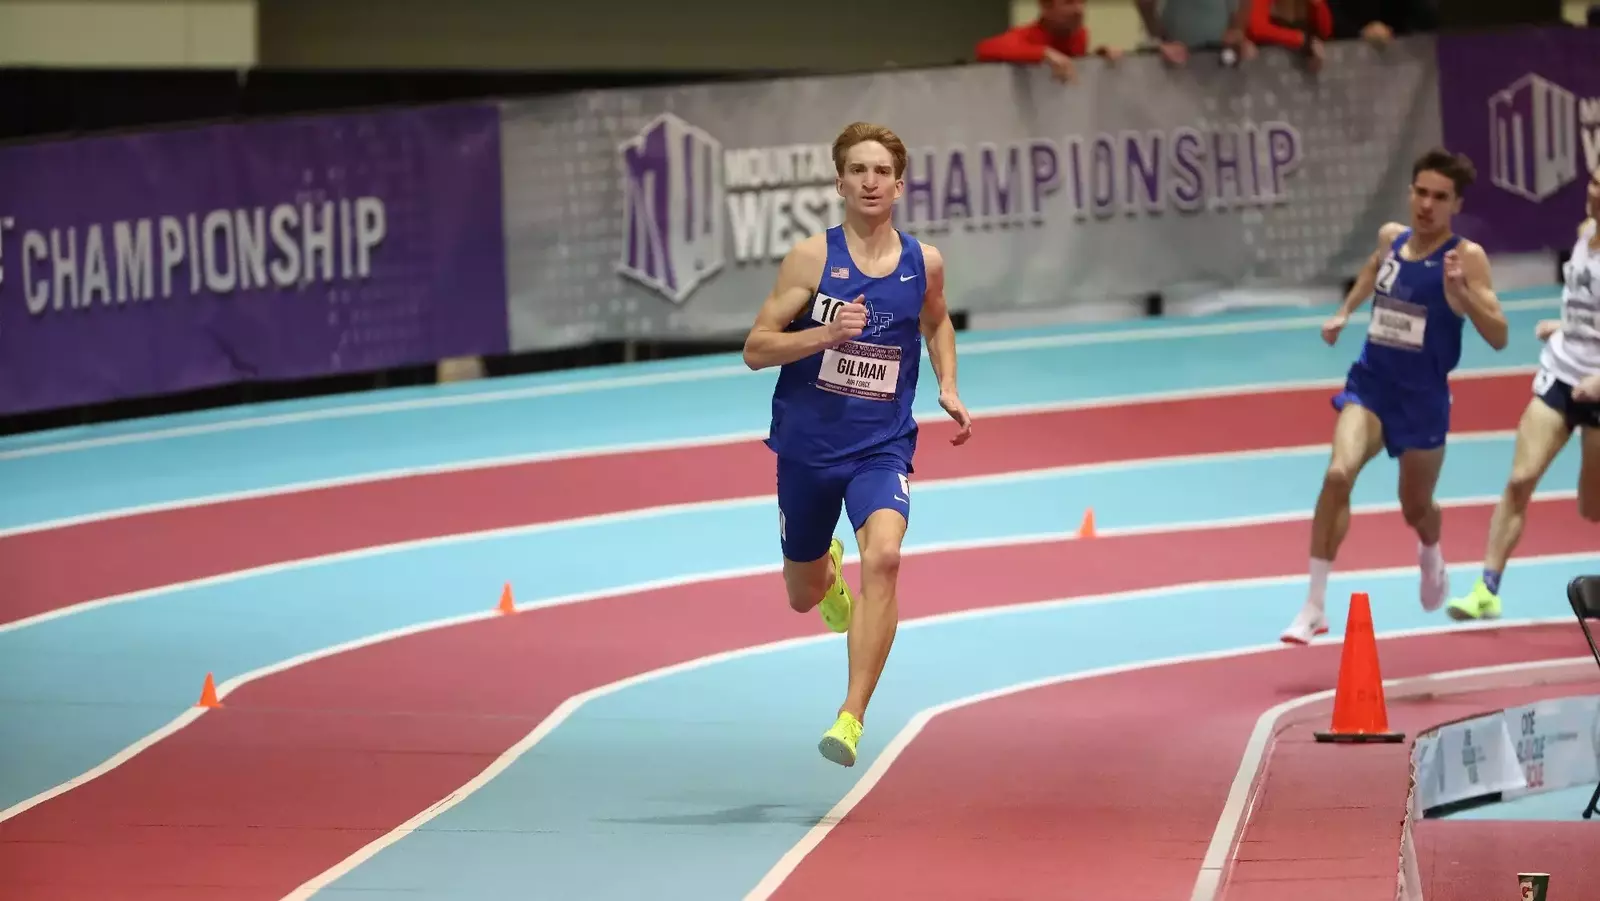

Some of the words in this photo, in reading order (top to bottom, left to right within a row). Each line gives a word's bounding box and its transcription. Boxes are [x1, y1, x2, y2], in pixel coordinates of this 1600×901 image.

[724, 145, 836, 187] MOUNTAI
[896, 124, 1300, 228] HAMPIONSHIP
[22, 197, 386, 315] CHAMPIONSHIP
[837, 358, 887, 381] GILMAN
